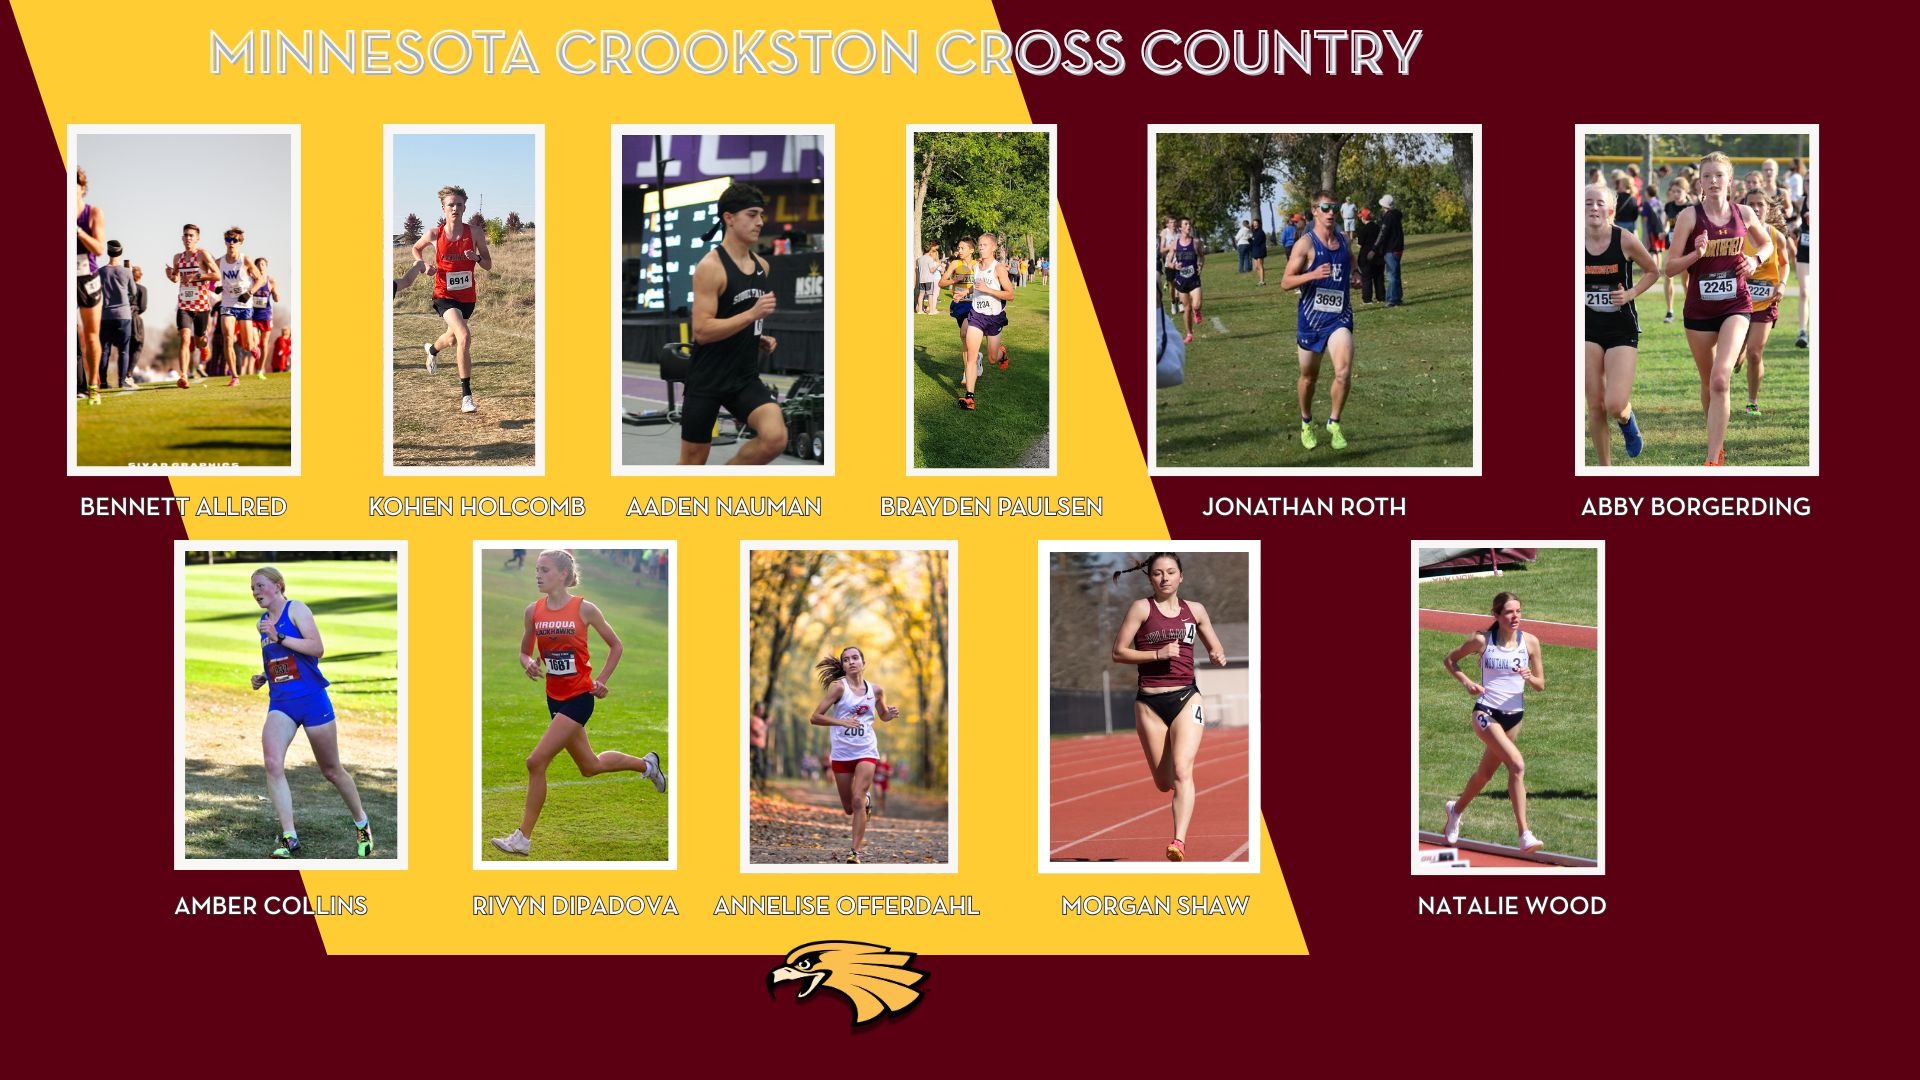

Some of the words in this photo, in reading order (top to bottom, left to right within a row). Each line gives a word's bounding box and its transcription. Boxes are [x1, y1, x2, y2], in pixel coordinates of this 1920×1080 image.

[222, 270, 240, 280] NW
[449, 275, 470, 286] 6914
[1703, 280, 1733, 294] 2245
[1748, 285, 1770, 297] 2224
[1315, 293, 1343, 307] 3693
[534, 620, 576, 630] VIROQUA
[535, 628, 576, 637] LACKHAWKS
[1187, 624, 1196, 642] 4
[1511, 657, 1521, 673] 3
[1194, 705, 1203, 724] 4
[1477, 714, 1488, 728] 3
[844, 723, 865, 737] 206
